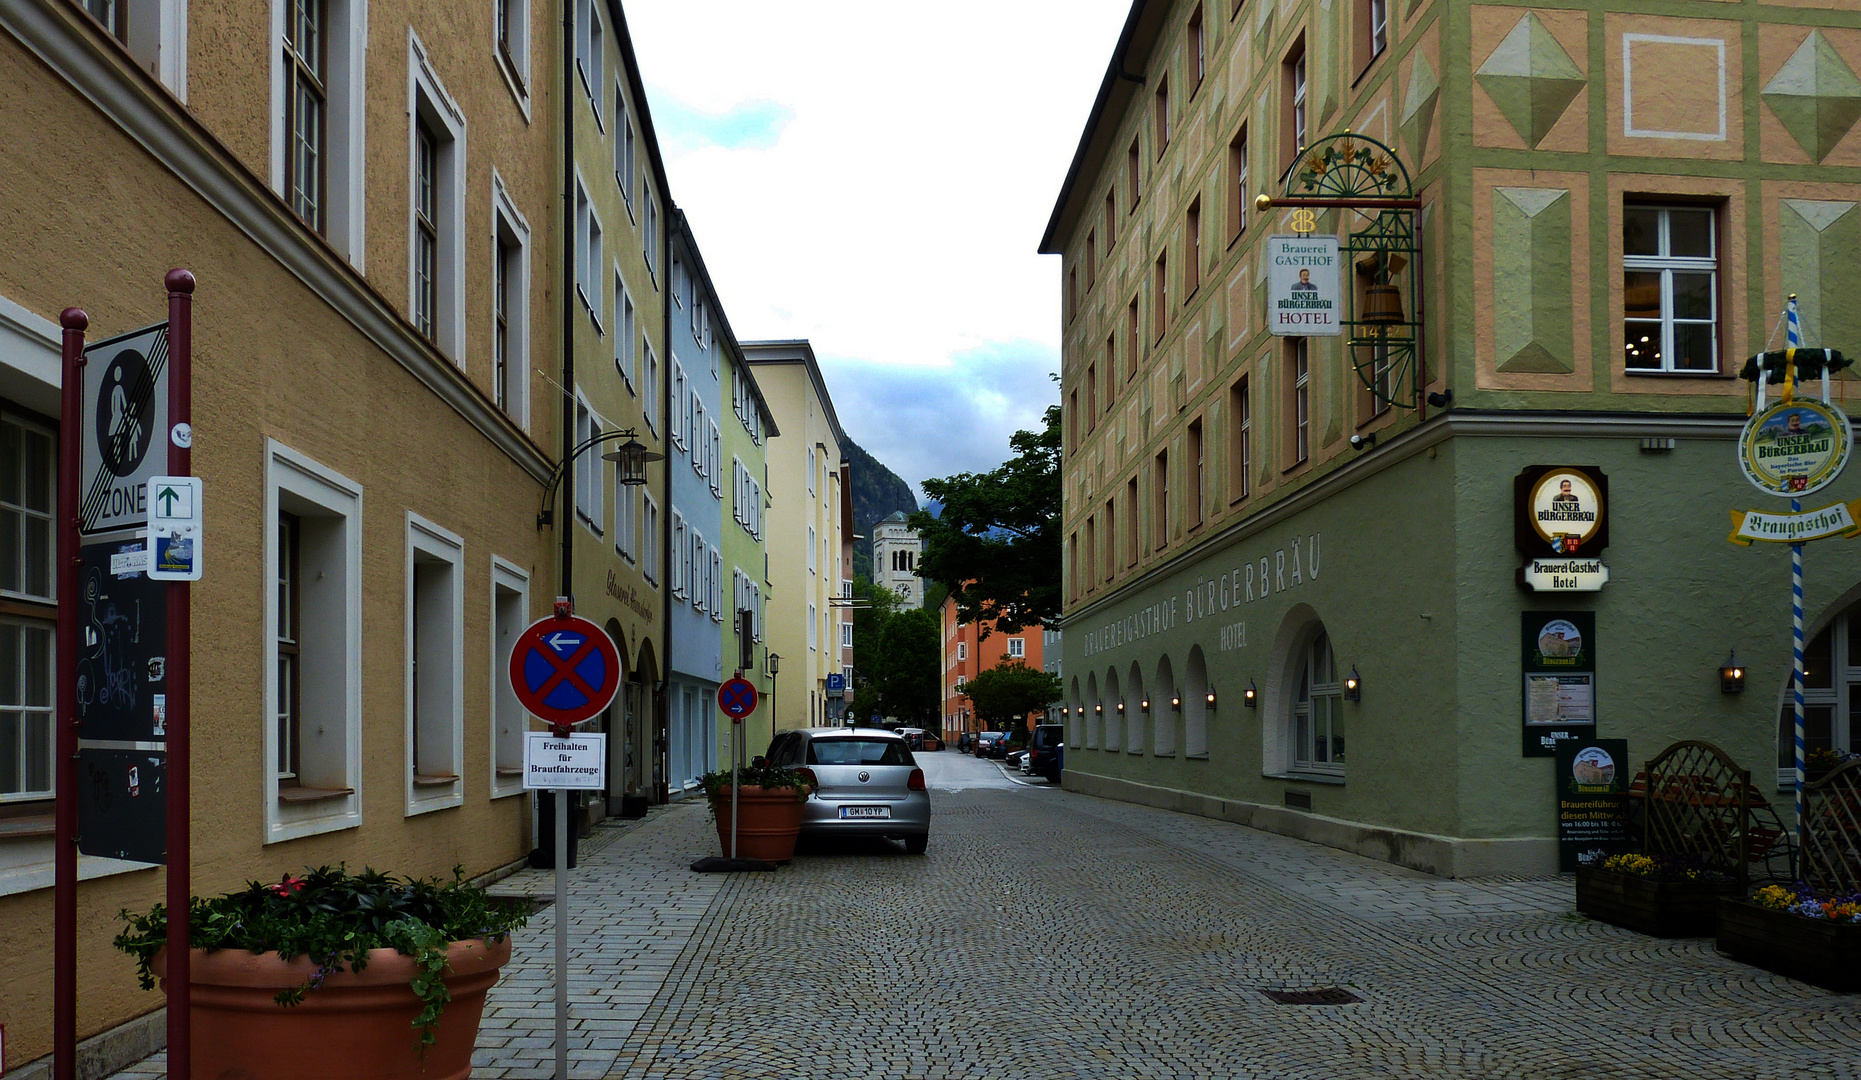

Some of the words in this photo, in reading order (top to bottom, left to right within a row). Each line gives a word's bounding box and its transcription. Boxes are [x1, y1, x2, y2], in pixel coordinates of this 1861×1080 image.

[1281, 243, 1327, 254] Brauerei
[1275, 255, 1334, 266] GASTHOF
[1291, 291, 1319, 301] UNSER
[1277, 299, 1333, 309] BÜRGERBRÄU
[1279, 312, 1333, 325] HOTEL
[1778, 435, 1811, 447] UNSER
[1759, 440, 1829, 458] BÜRGERBRÄU
[102, 483, 147, 519] ZONE
[1553, 503, 1580, 511] UNSER
[1538, 511, 1595, 521] BÜRGERBRÄU
[1534, 561, 1568, 574] Brauerei
[1569, 560, 1601, 574] Gasthof
[1553, 575, 1578, 588] Hotel
[1084, 596, 1177, 657] BRAUEREIGASTHOF
[1186, 532, 1321, 623] BÜRGERBRÄU
[1219, 621, 1248, 652] HOTEL
[543, 741, 588, 751] Freihalten
[558, 753, 573, 762] für
[531, 764, 599, 775] Brautfahrzeuge
[1561, 812, 1588, 820] diesen
[1590, 811, 1628, 820] Mittwch
